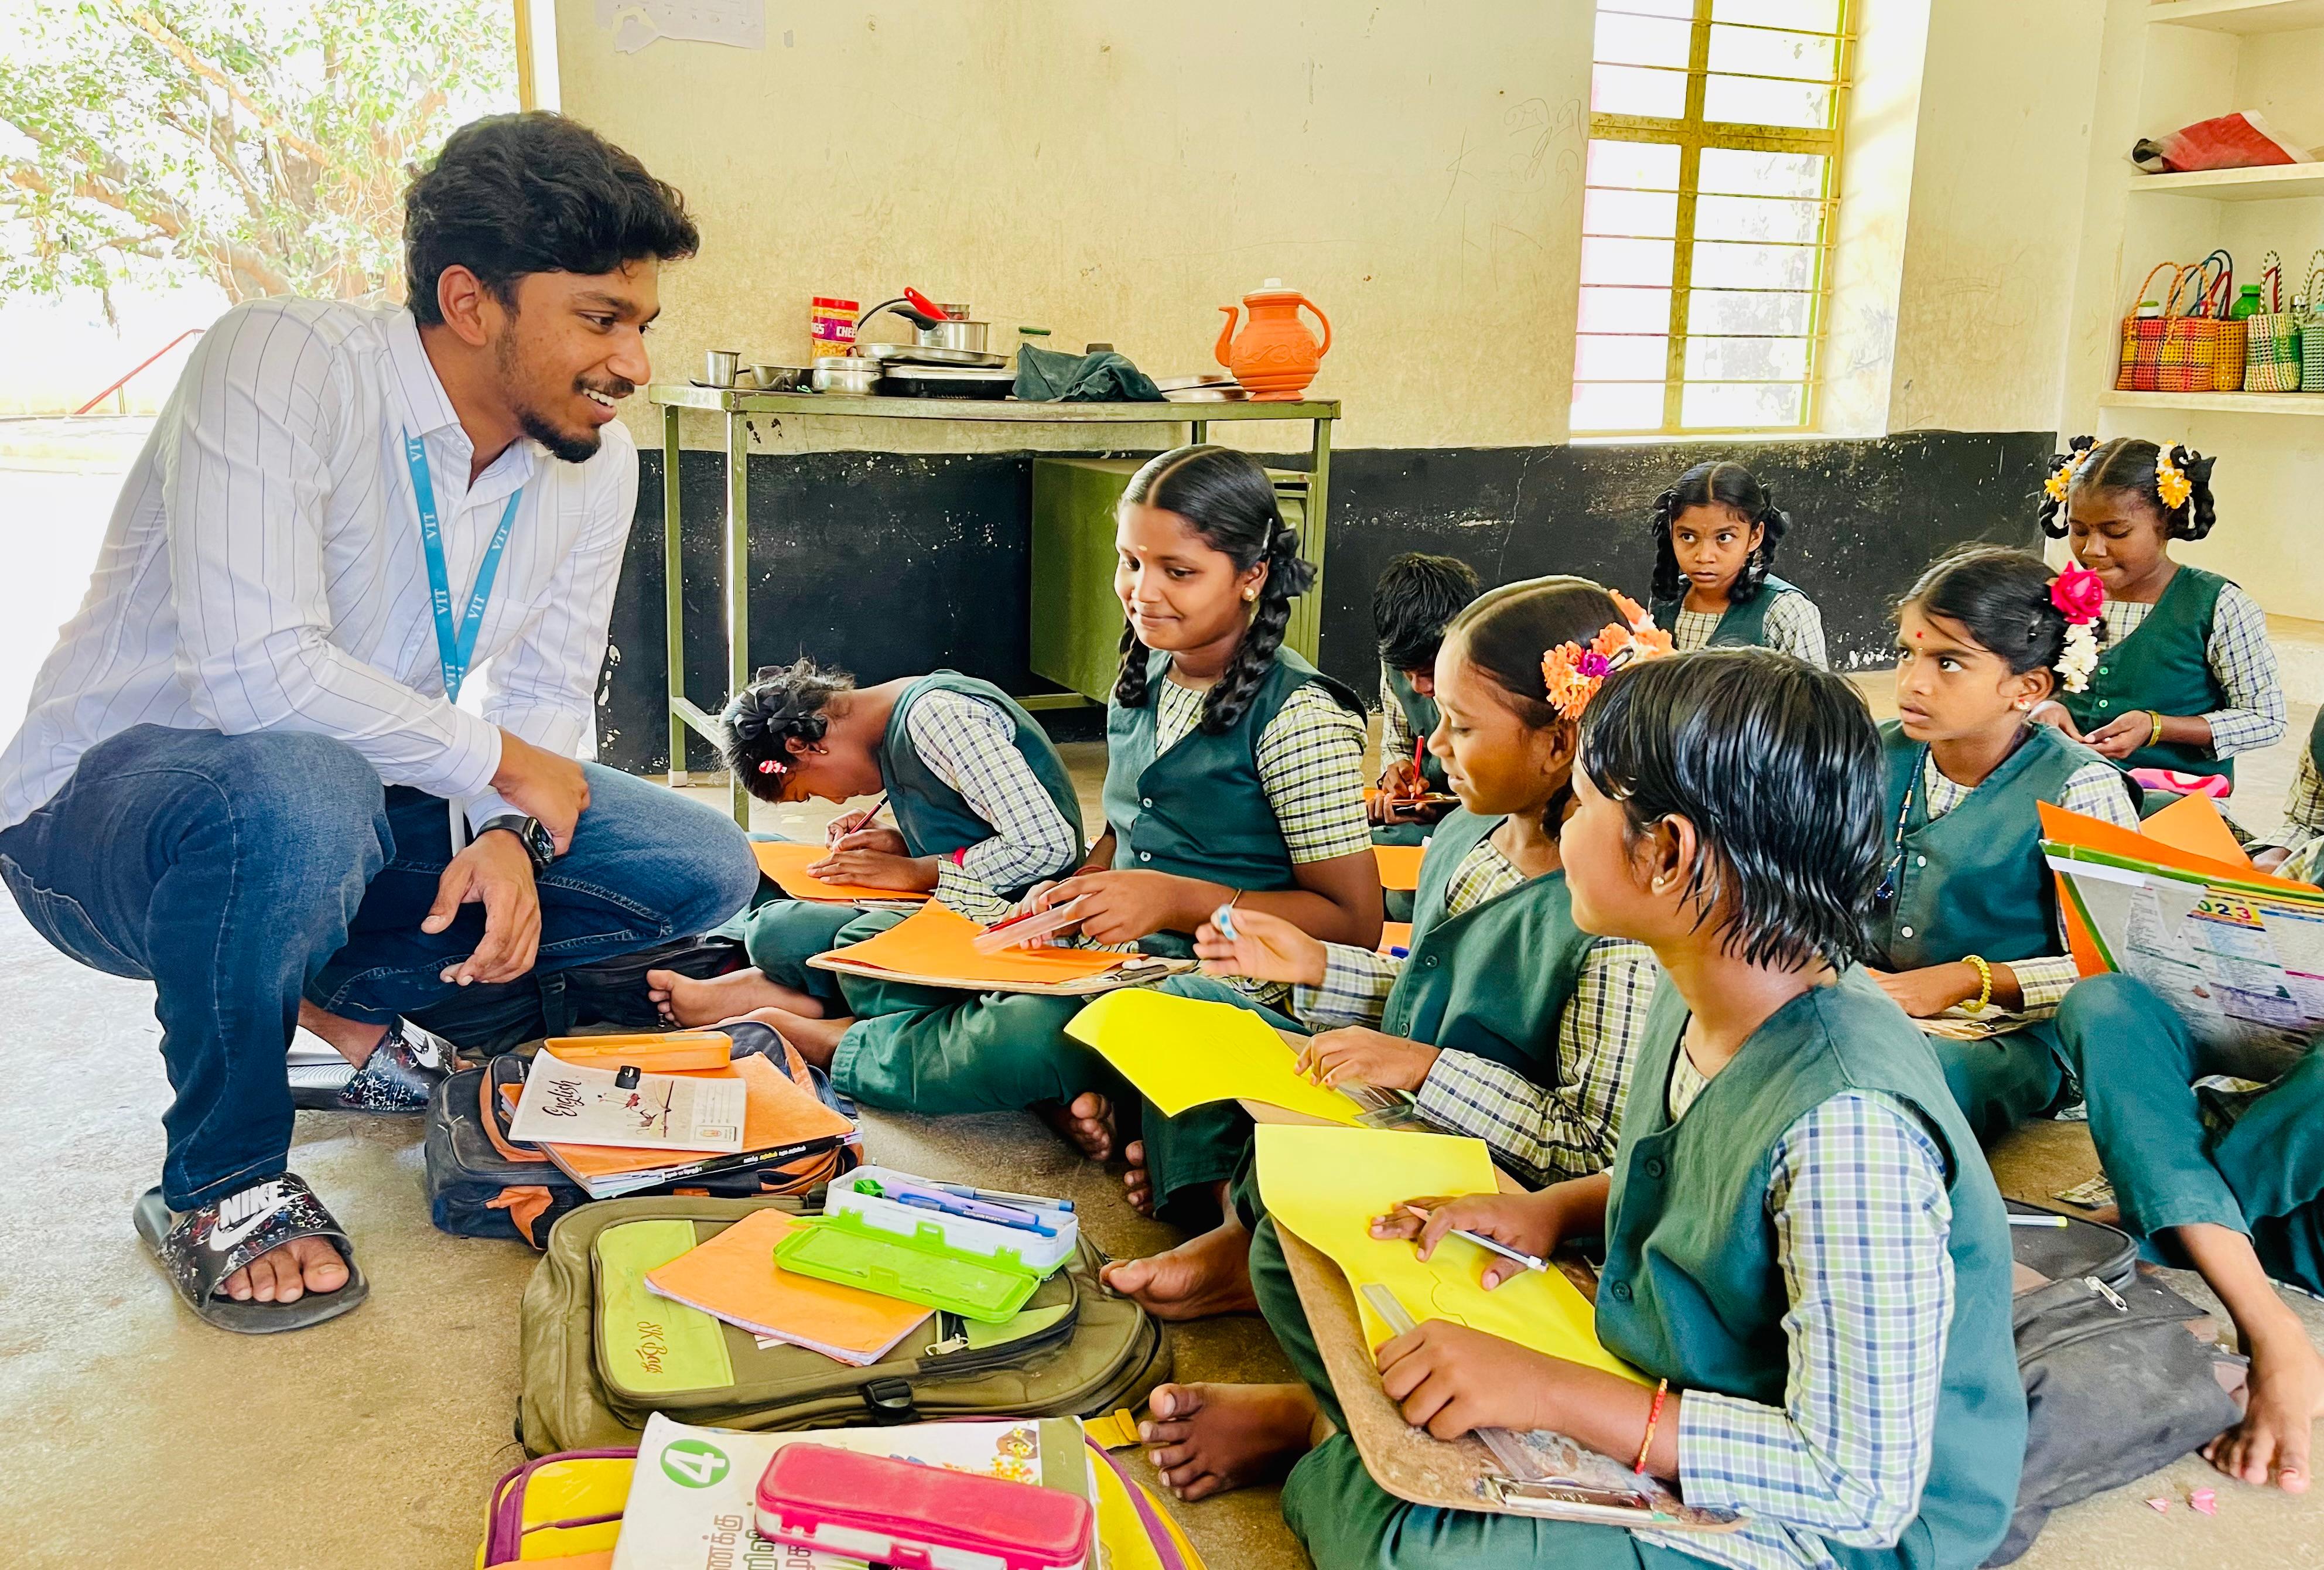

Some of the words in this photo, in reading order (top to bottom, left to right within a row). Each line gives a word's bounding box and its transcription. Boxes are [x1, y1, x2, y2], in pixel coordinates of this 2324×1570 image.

[423, 512, 438, 540] VIT
[491, 525, 509, 552] VIT
[434, 588, 449, 616] VIT
[468, 593, 486, 619] VIT
[445, 661, 457, 688] VIT
[542, 1080, 585, 1117] English
[218, 1179, 285, 1230] NIKE
[665, 1450, 725, 1483] 4
